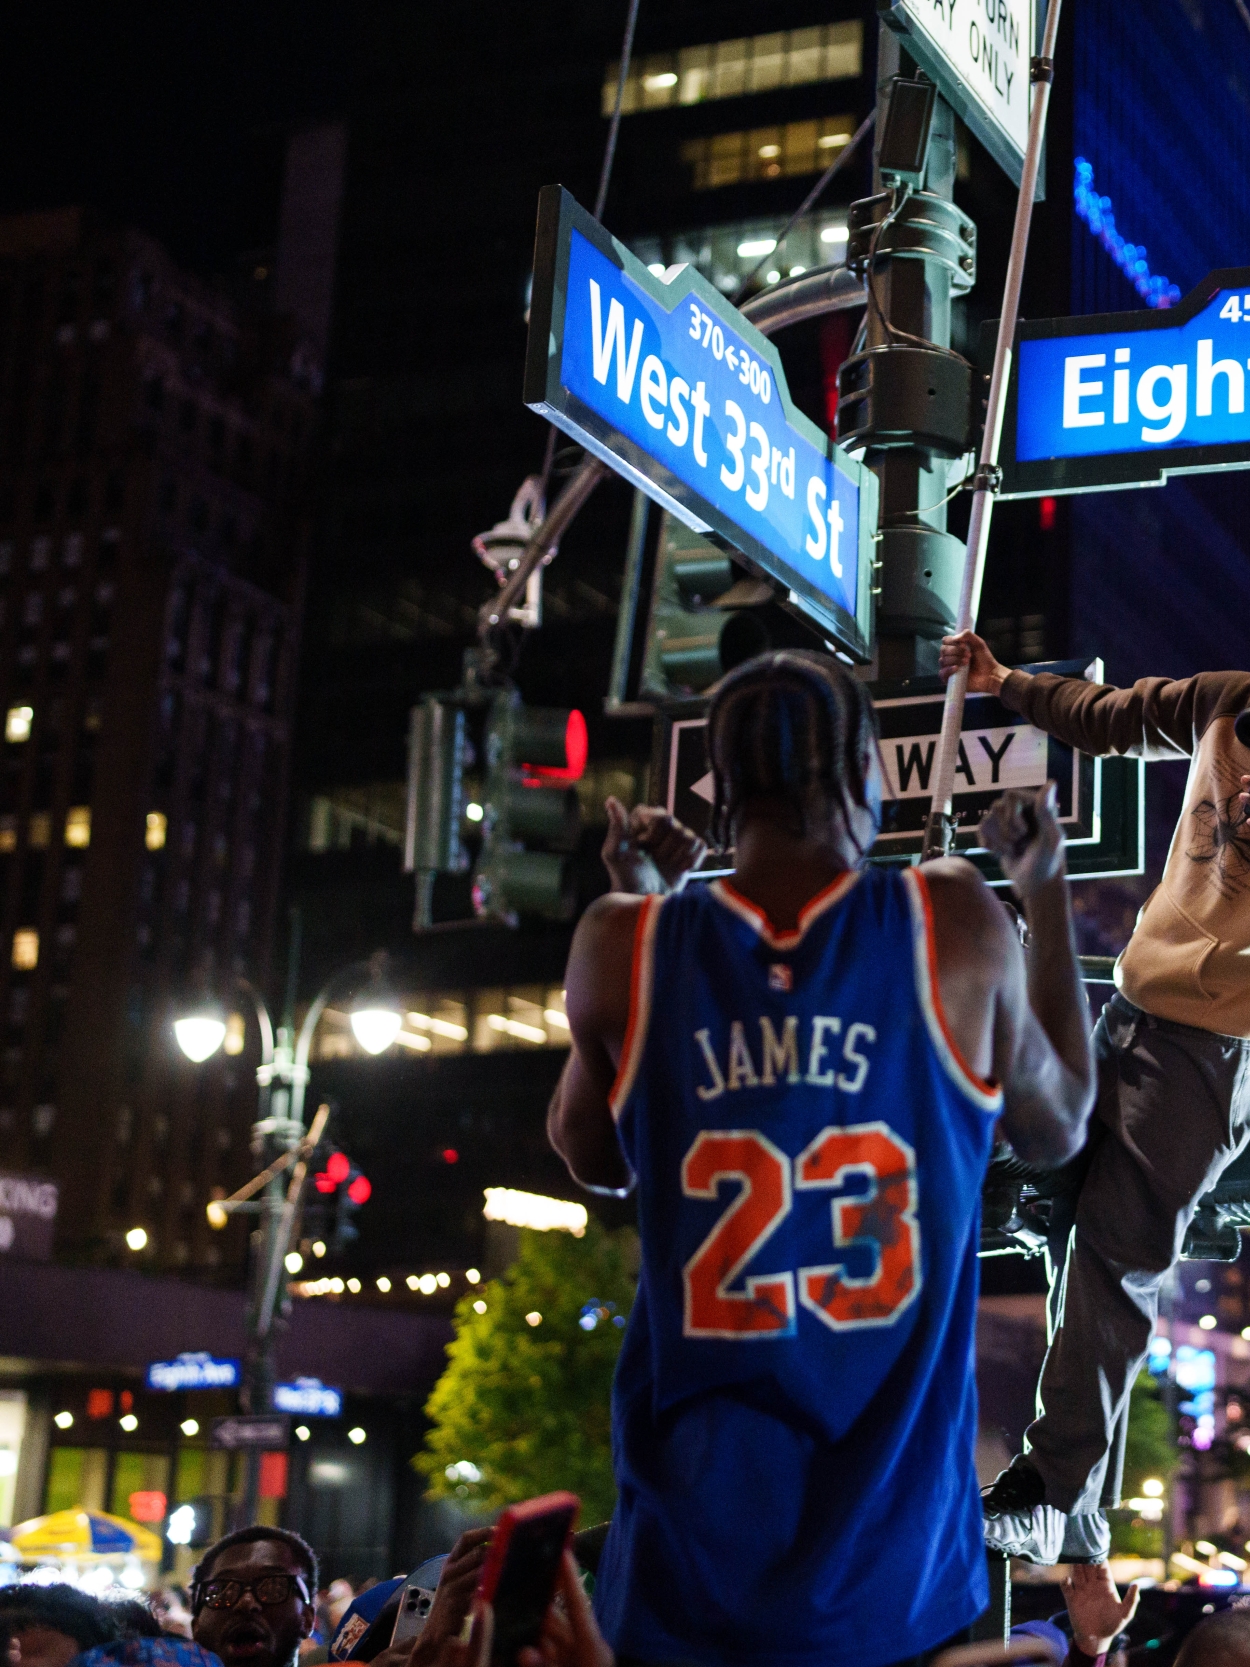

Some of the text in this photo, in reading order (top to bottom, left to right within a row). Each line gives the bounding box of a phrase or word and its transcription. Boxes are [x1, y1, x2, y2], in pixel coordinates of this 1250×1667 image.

[970, 20, 1014, 105] ONLY
[977, 0, 1019, 58] URN
[590, 278, 845, 579] West 33rd St
[895, 732, 1016, 792] WAY
[694, 1015, 876, 1100] JAMES
[681, 1120, 923, 1339] 23
